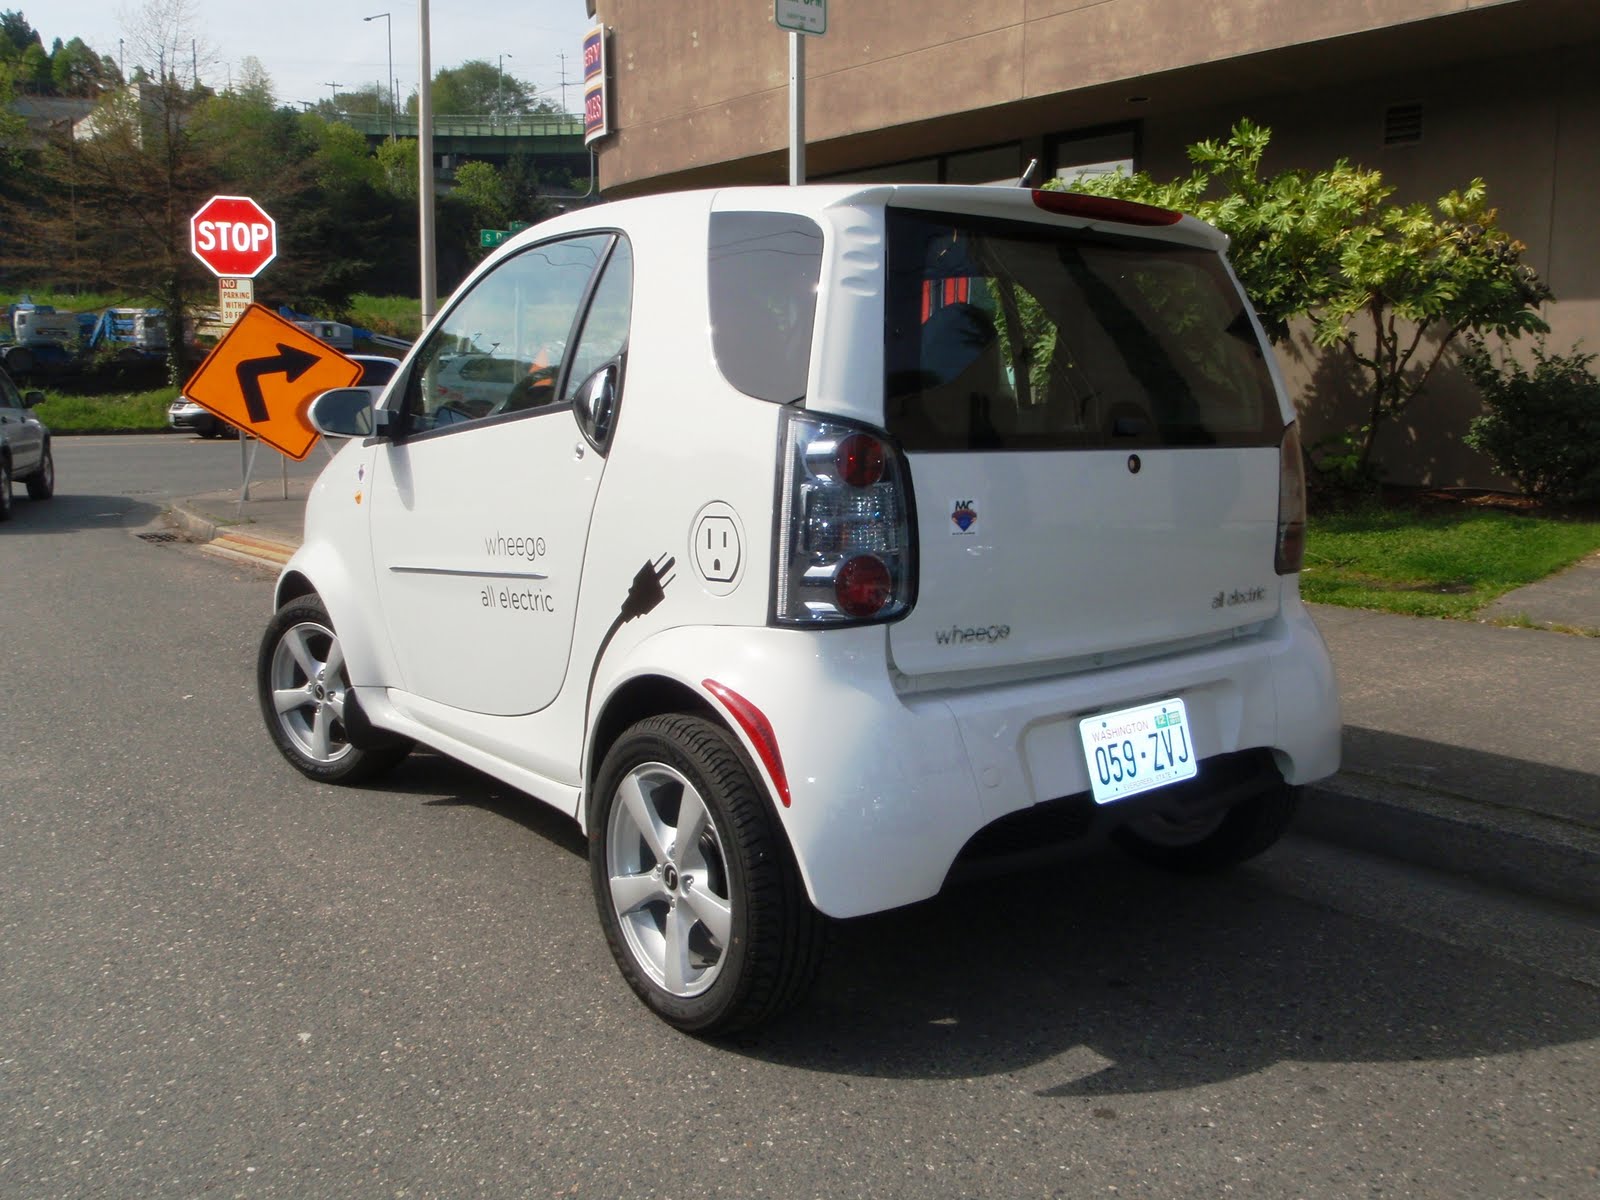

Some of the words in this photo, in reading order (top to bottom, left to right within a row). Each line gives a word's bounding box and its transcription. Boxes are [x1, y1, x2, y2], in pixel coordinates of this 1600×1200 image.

[198, 221, 269, 251] STOP
[222, 280, 235, 288] NO
[223, 291, 250, 299] PARKING
[225, 311, 233, 319] 30
[955, 500, 974, 511] MC
[485, 529, 546, 562] wheego
[481, 585, 496, 607] all
[500, 586, 554, 612] electric
[935, 624, 1010, 645] wheego
[1092, 720, 1149, 742] WASHINGTON
